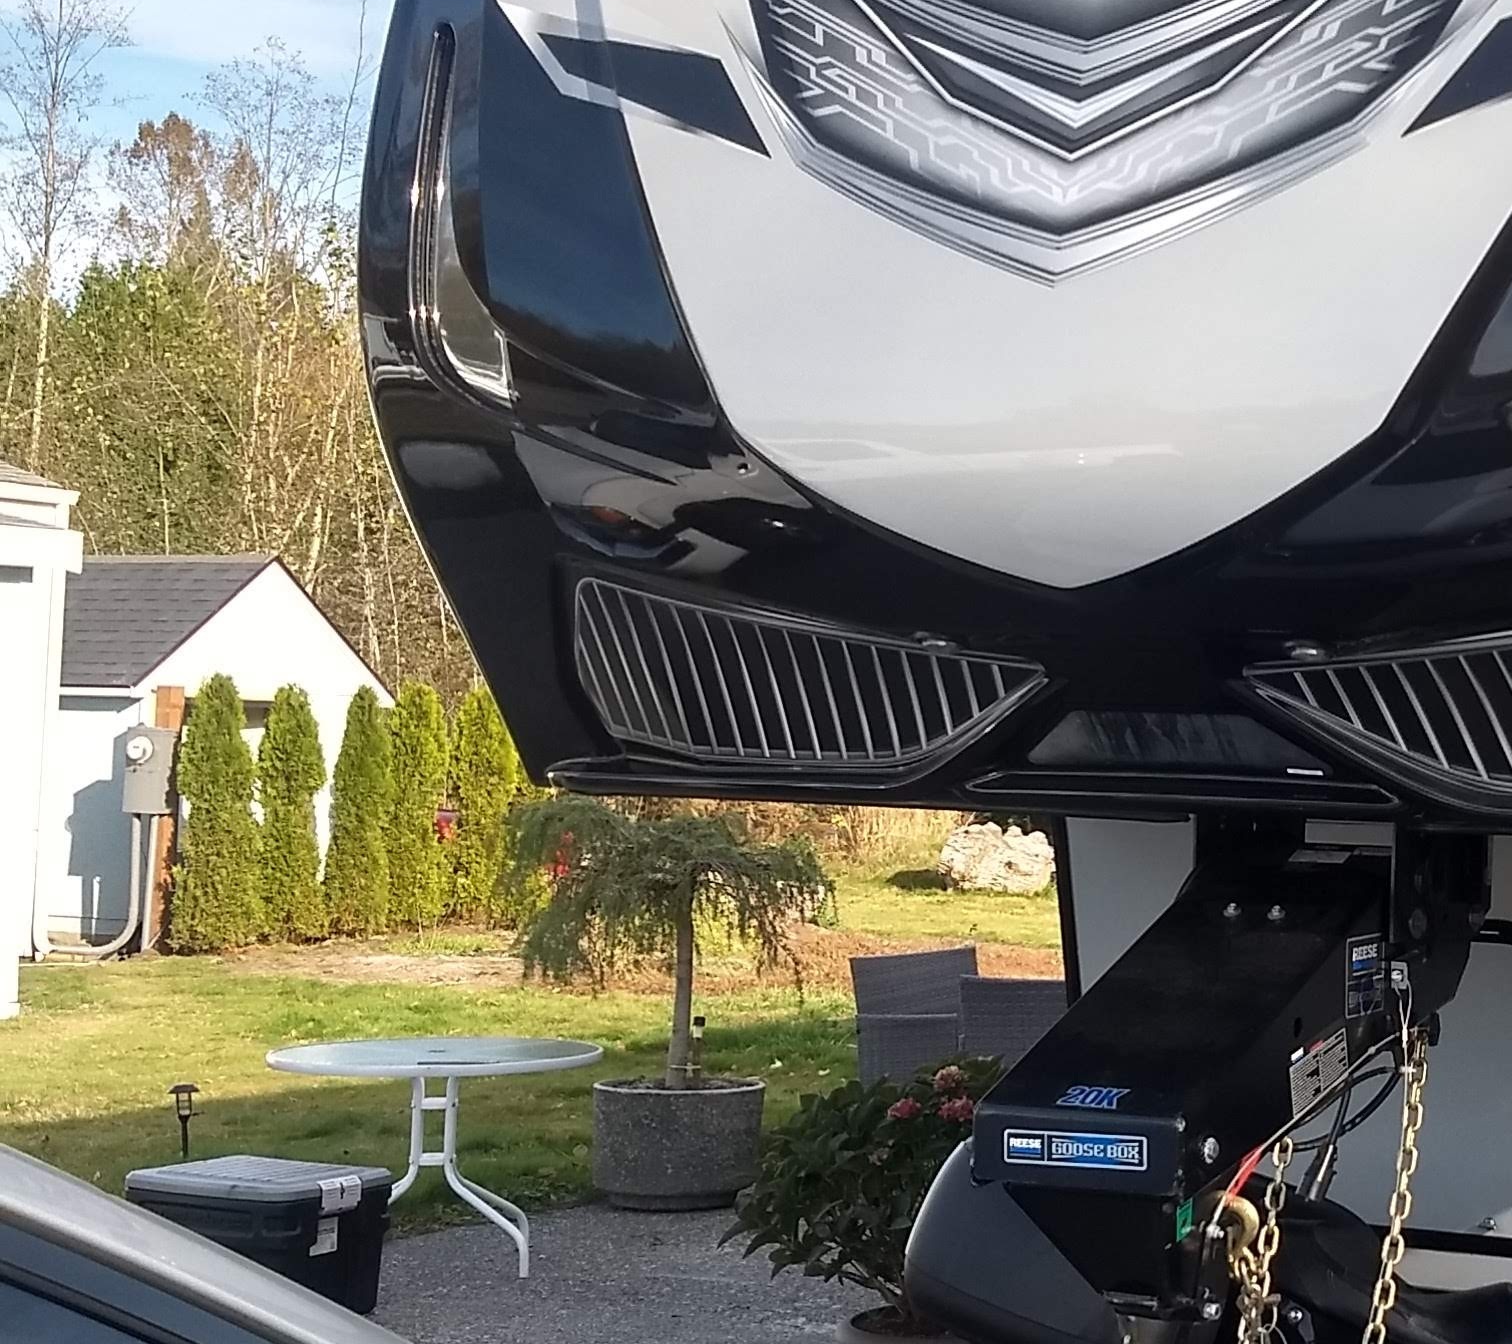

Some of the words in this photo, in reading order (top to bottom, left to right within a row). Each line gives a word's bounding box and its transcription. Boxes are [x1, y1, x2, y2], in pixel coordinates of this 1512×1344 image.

[1352, 943, 1378, 962] REESE
[1056, 1085, 1131, 1109] 20K
[1009, 1136, 1042, 1149] REESE
[1051, 1141, 1104, 1157] GOOSE
[1106, 1142, 1139, 1160] BOX
